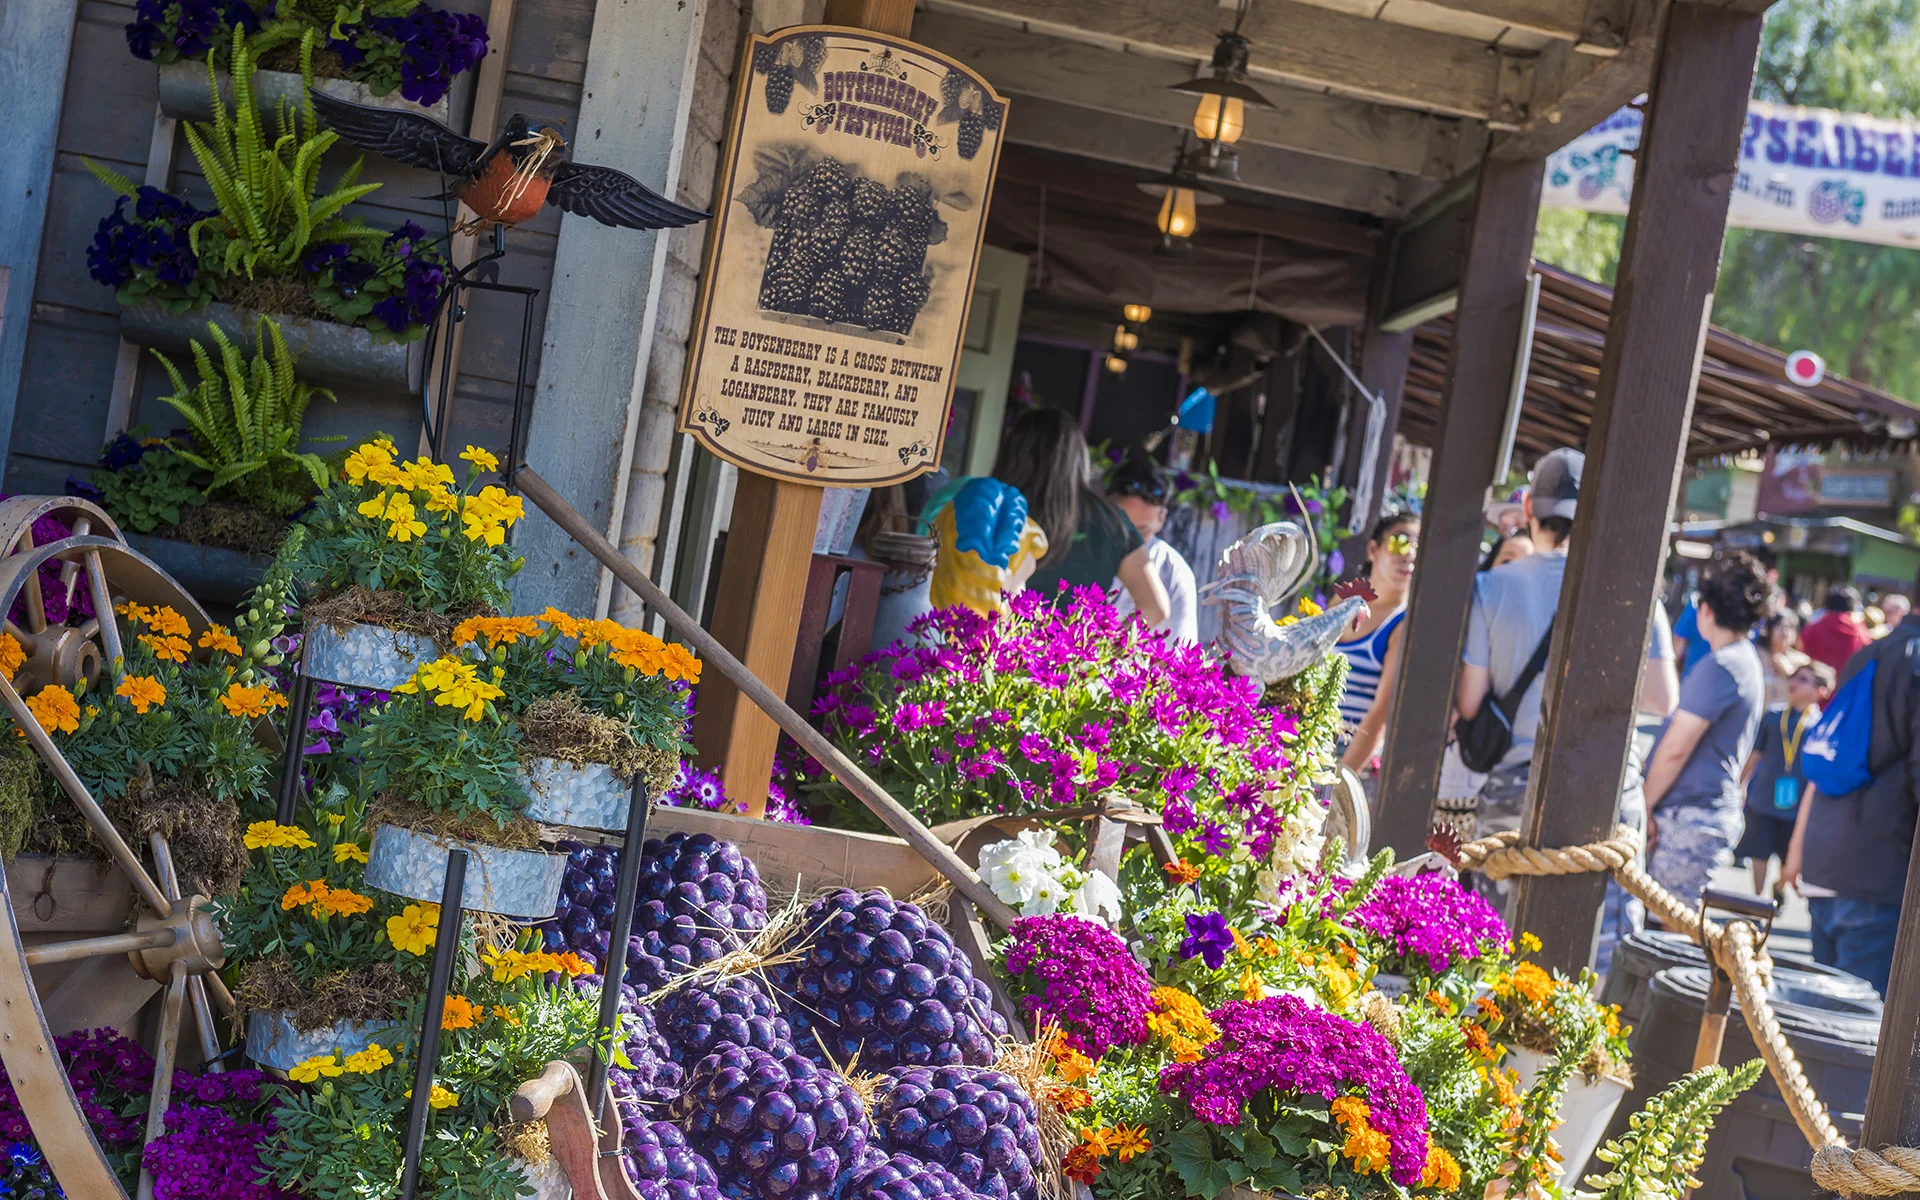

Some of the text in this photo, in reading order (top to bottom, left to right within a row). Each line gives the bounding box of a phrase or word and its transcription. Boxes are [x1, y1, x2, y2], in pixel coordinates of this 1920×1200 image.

[823, 71, 939, 127] BOYSENBERRY
[834, 101, 913, 148] FESTIVAL
[714, 326, 943, 383] THE BOYSENBERRY IS A CROSS BETWEEN
[730, 354, 918, 403] A RASPBERRY, BLACKBERRY, AND
[721, 378, 919, 427] LOGANBERRY. THEY ARE FAMOUSLY
[742, 407, 889, 447] JUICY AND LARGE IN SIZE.
